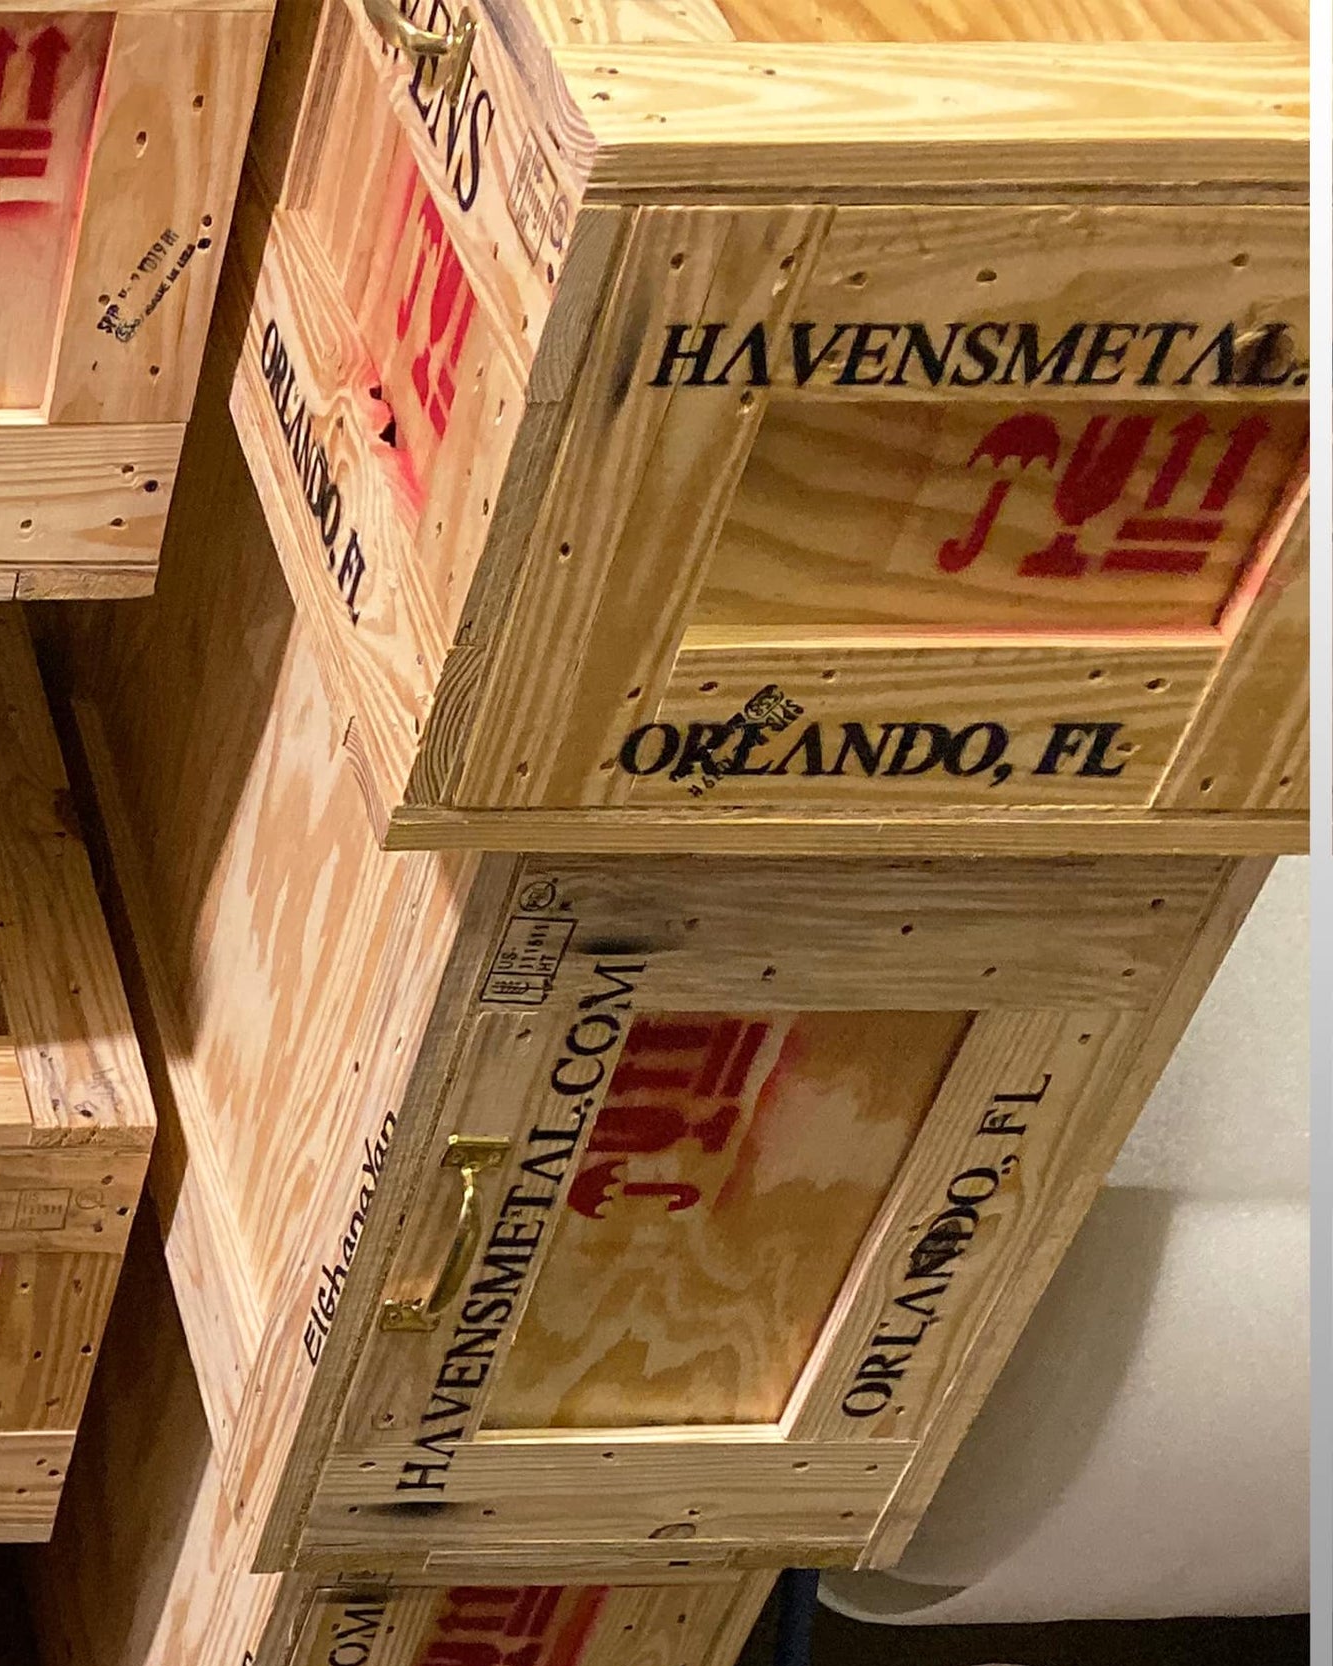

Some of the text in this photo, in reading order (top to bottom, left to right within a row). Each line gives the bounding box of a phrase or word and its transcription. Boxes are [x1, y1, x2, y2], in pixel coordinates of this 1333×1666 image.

[619, 721, 1015, 785] ORLANDO,
[1031, 721, 1128, 778] FL
[395, 960, 647, 1493] HAVENSMETAL.COM
[842, 1073, 1052, 1418] ORLANDO, FL
